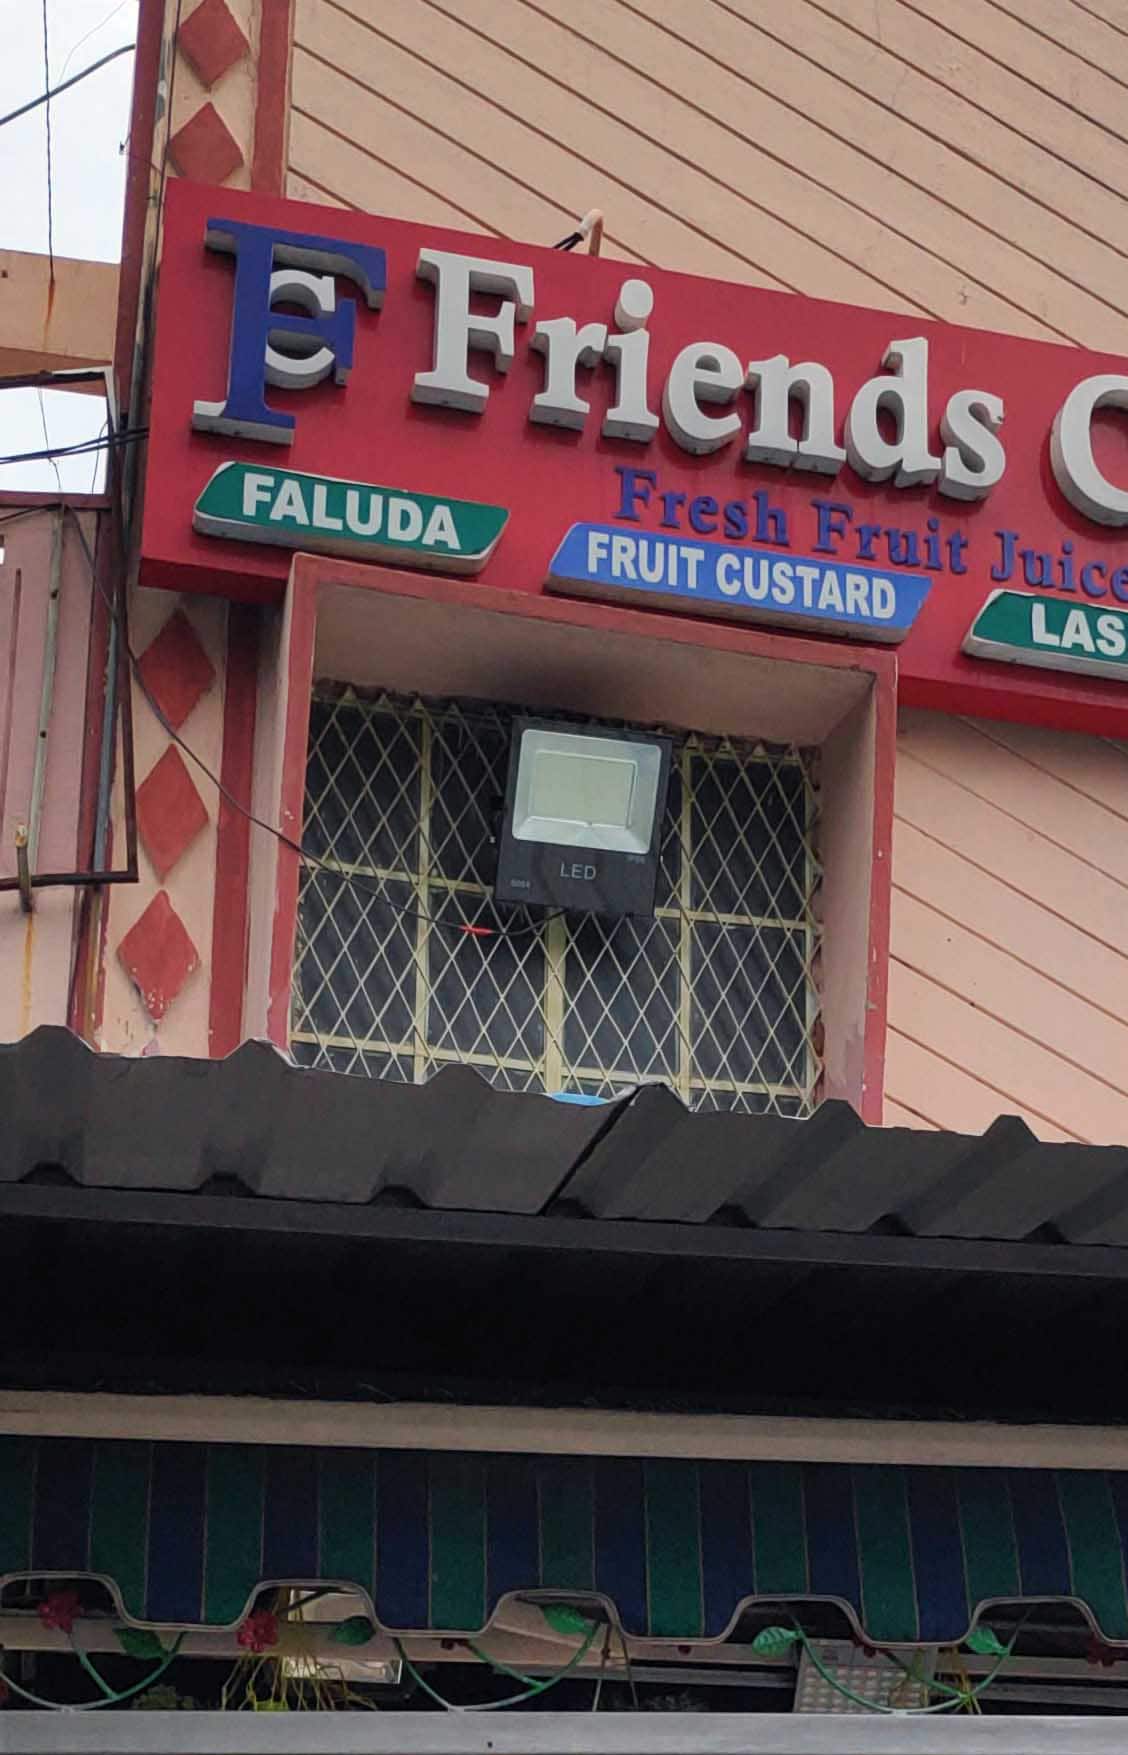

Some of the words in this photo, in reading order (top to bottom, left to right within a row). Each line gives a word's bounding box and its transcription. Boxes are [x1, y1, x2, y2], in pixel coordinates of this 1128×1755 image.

[410, 248, 1006, 502] Friends
[241, 472, 463, 551] FALUDA
[613, 466, 790, 547] Fresh
[811, 500, 968, 574] Fruit
[587, 531, 704, 589] FRUIT
[716, 553, 897, 620] CUSTARD
[559, 861, 597, 881] LED
